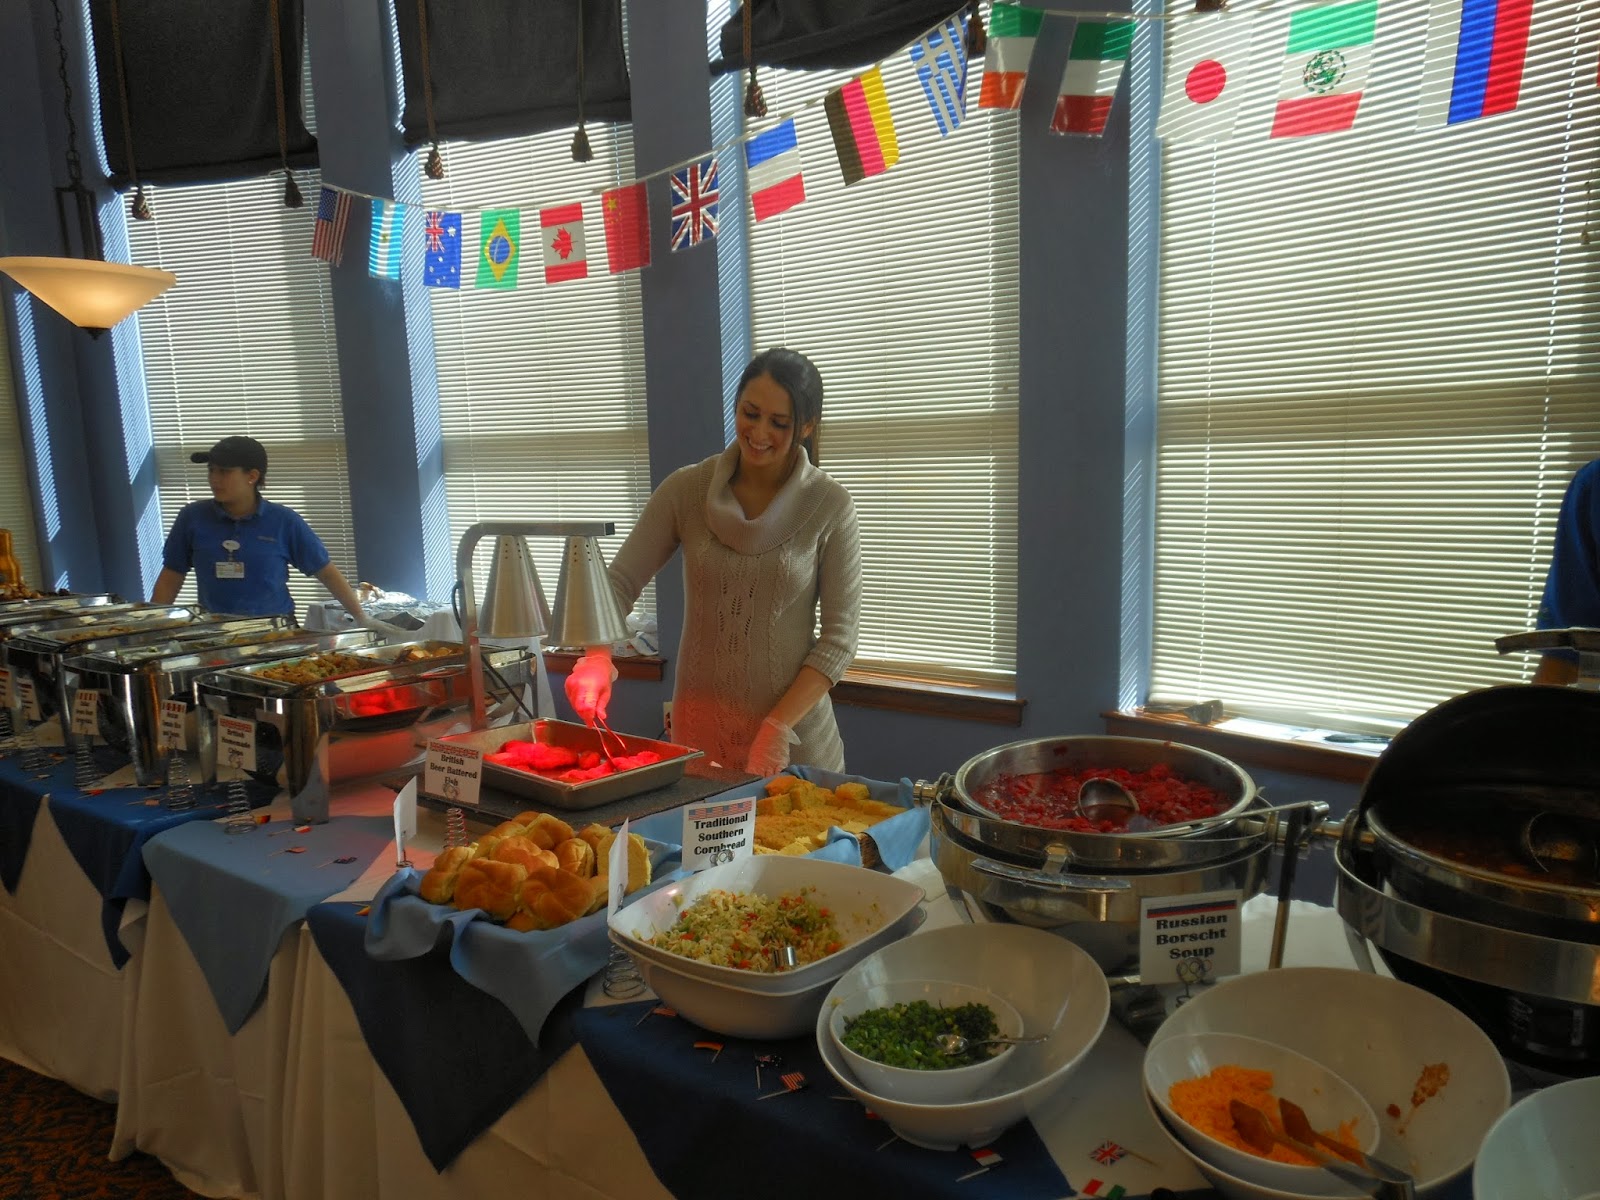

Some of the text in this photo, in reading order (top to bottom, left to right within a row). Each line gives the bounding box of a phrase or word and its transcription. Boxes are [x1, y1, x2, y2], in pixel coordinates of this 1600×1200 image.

[441, 754, 464, 766] British
[430, 762, 478, 779] Beer Battered
[444, 776, 459, 787] Fish
[694, 813, 749, 829] Traditional
[698, 828, 744, 842] Southern
[694, 838, 746, 855] Cornbread
[1156, 914, 1228, 930] Russian
[1156, 928, 1227, 946] Borscht
[1169, 946, 1215, 960] Soup
